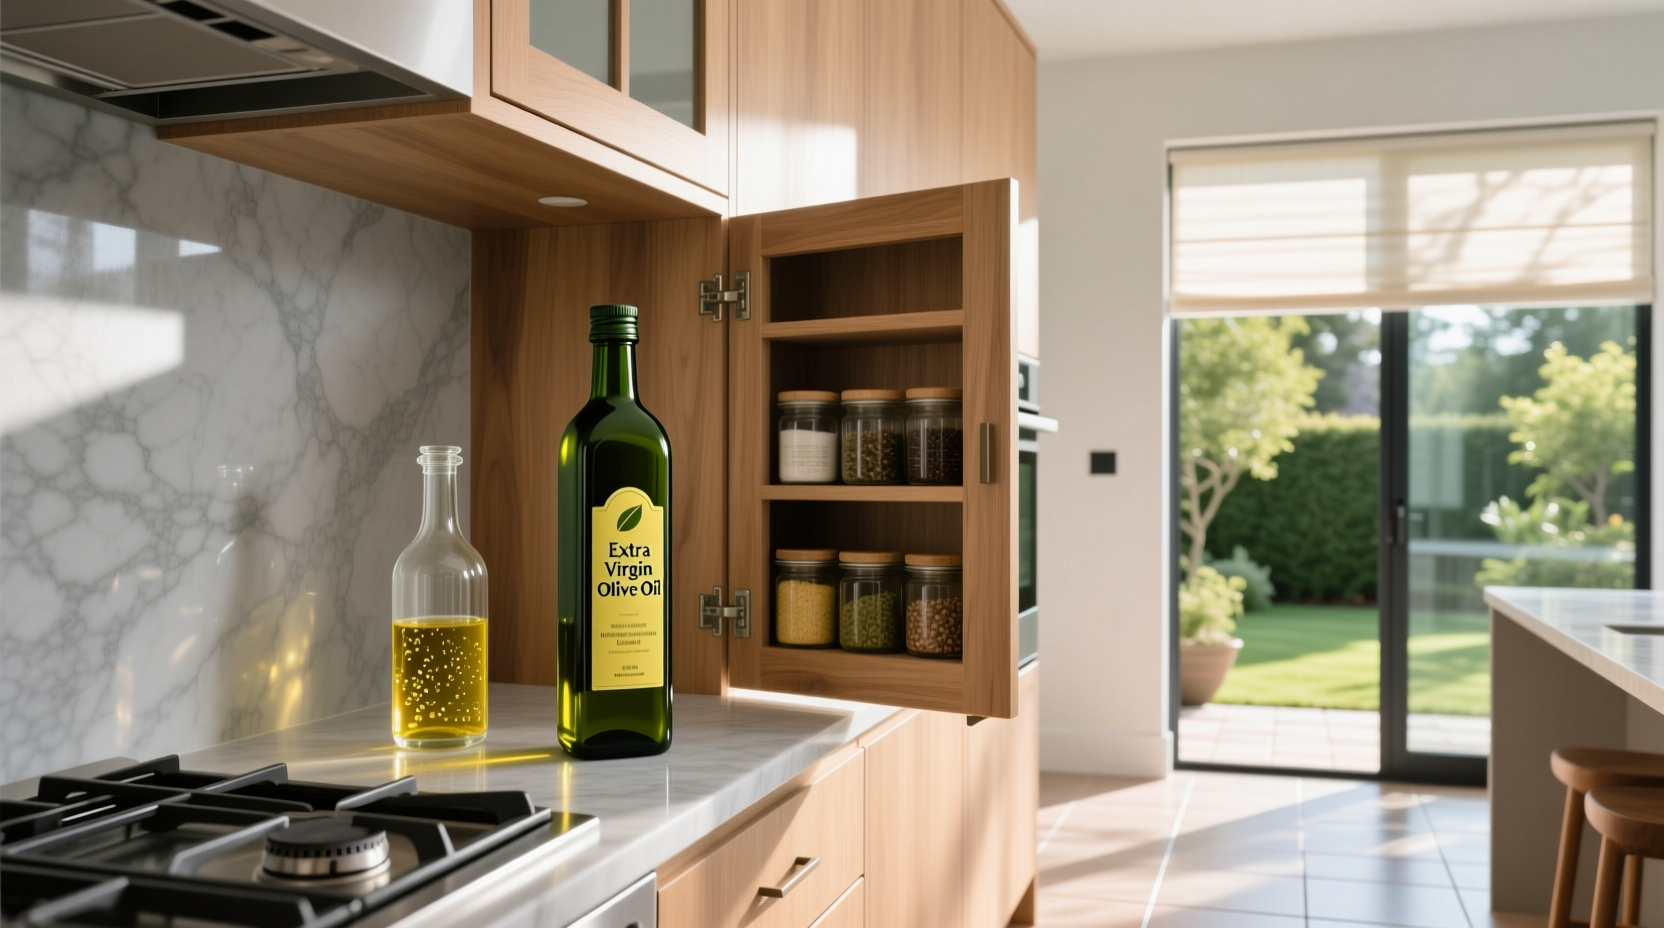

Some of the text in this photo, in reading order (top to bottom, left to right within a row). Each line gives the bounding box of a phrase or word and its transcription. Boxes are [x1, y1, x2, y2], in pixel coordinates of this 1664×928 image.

[609, 542, 651, 558] Extra
[604, 560, 653, 581] Virgin
[597, 579, 661, 597] Olive Oil
